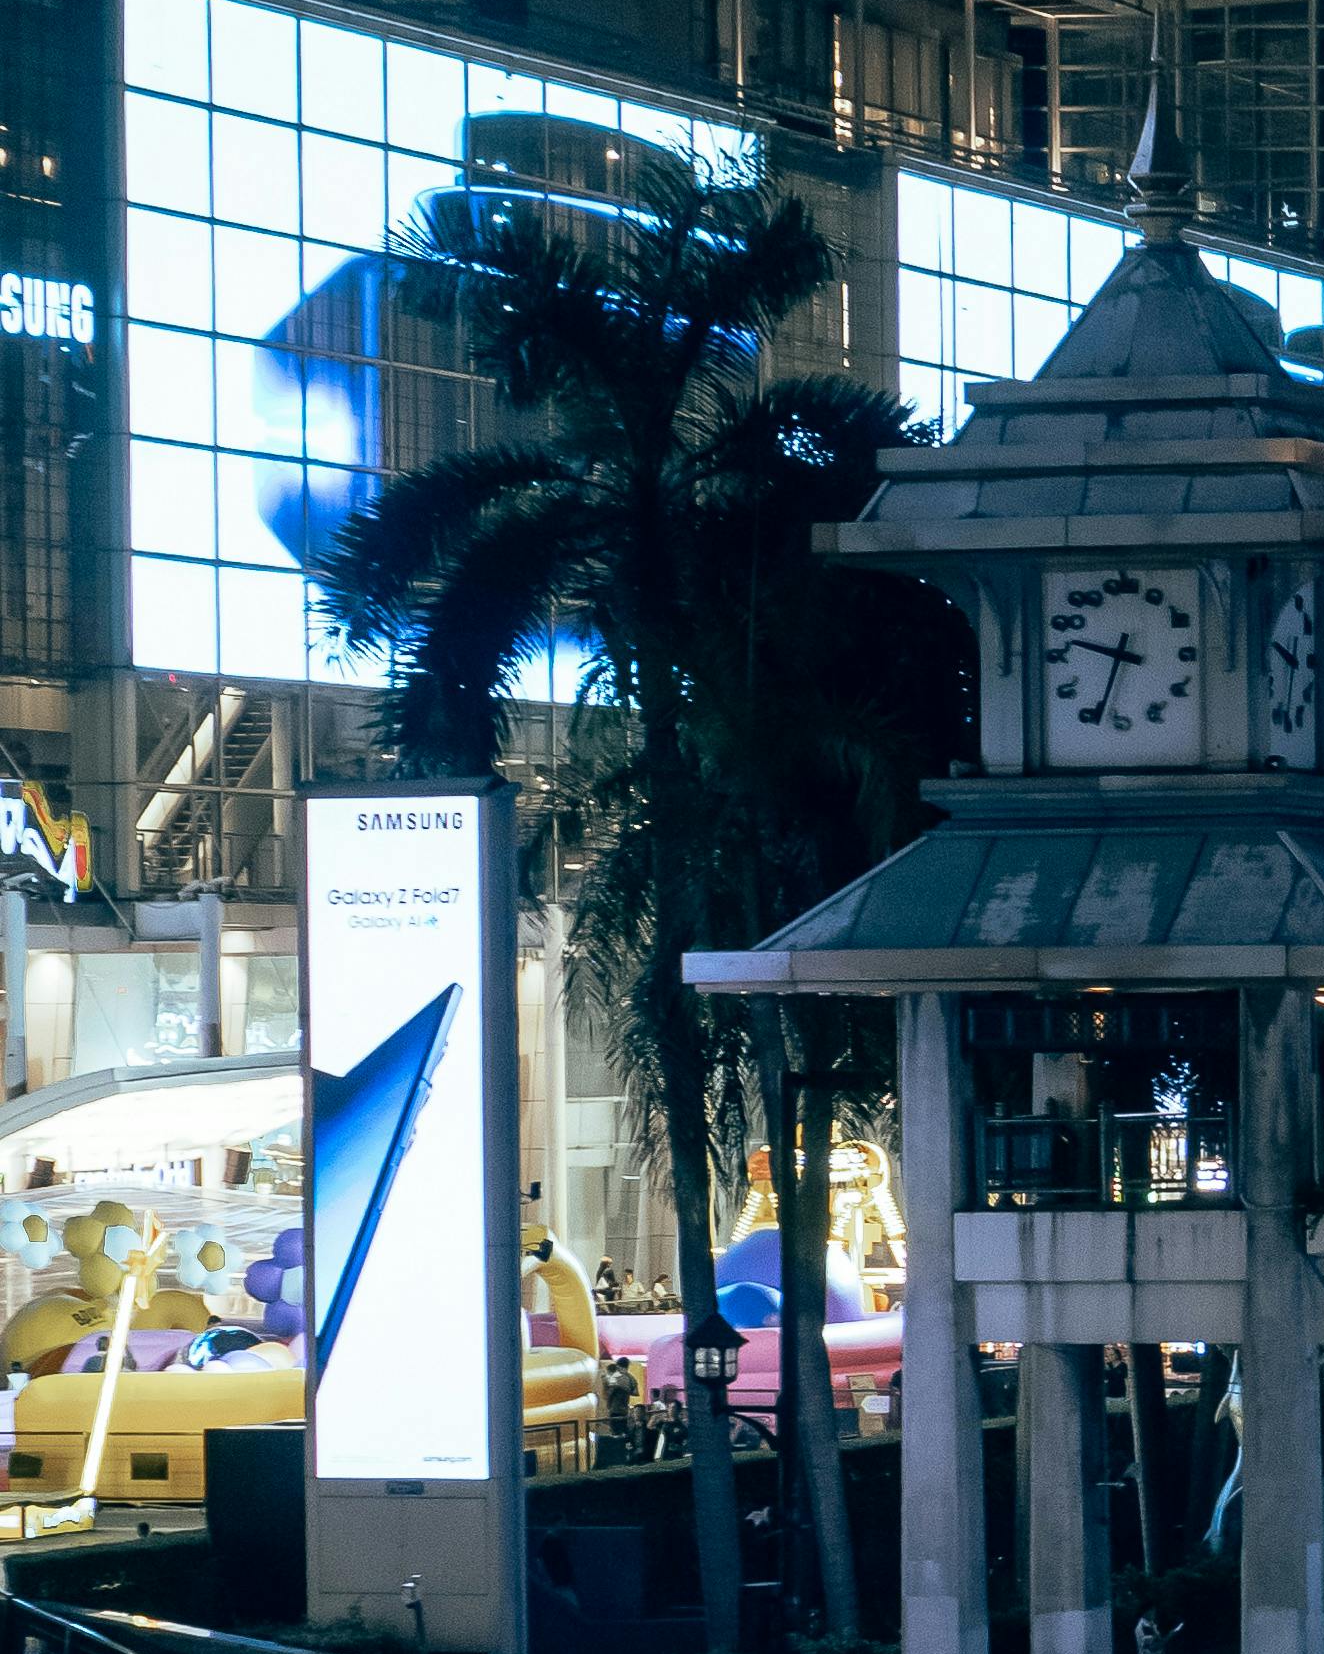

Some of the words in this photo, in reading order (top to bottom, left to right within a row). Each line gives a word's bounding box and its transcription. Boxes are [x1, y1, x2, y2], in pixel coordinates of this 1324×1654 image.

[357, 812, 463, 831] SAMSUNG
[327, 888, 394, 908] Galaxy
[398, 888, 408, 904] Z
[412, 888, 460, 904] Fold7
[348, 915, 403, 931] Galaxy
